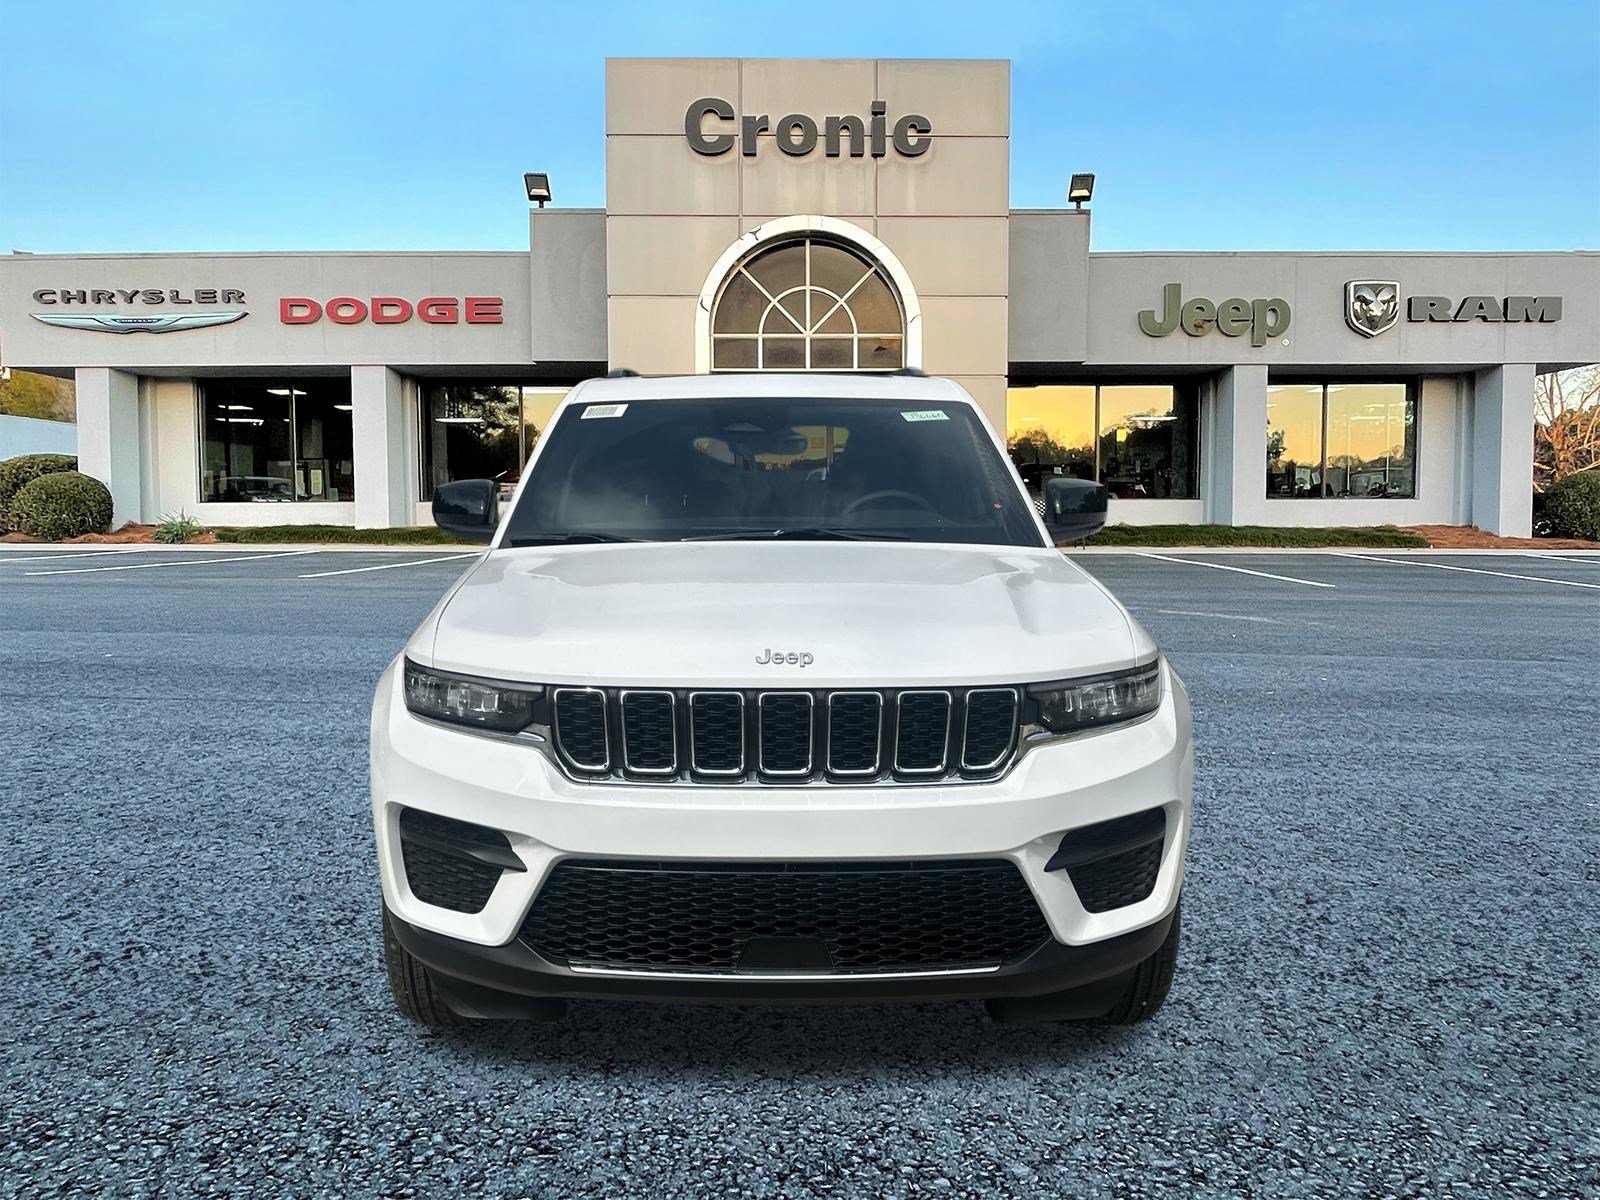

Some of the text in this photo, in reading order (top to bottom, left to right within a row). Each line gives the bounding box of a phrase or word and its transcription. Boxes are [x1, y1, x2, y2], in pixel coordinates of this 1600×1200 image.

[685, 98, 931, 157] Cronic
[32, 289, 246, 304] CHRYSLER
[1407, 296, 1562, 322] RAM
[279, 297, 503, 324] DODGE
[1138, 283, 1291, 347] Jeep
[755, 648, 814, 668] Jeep
